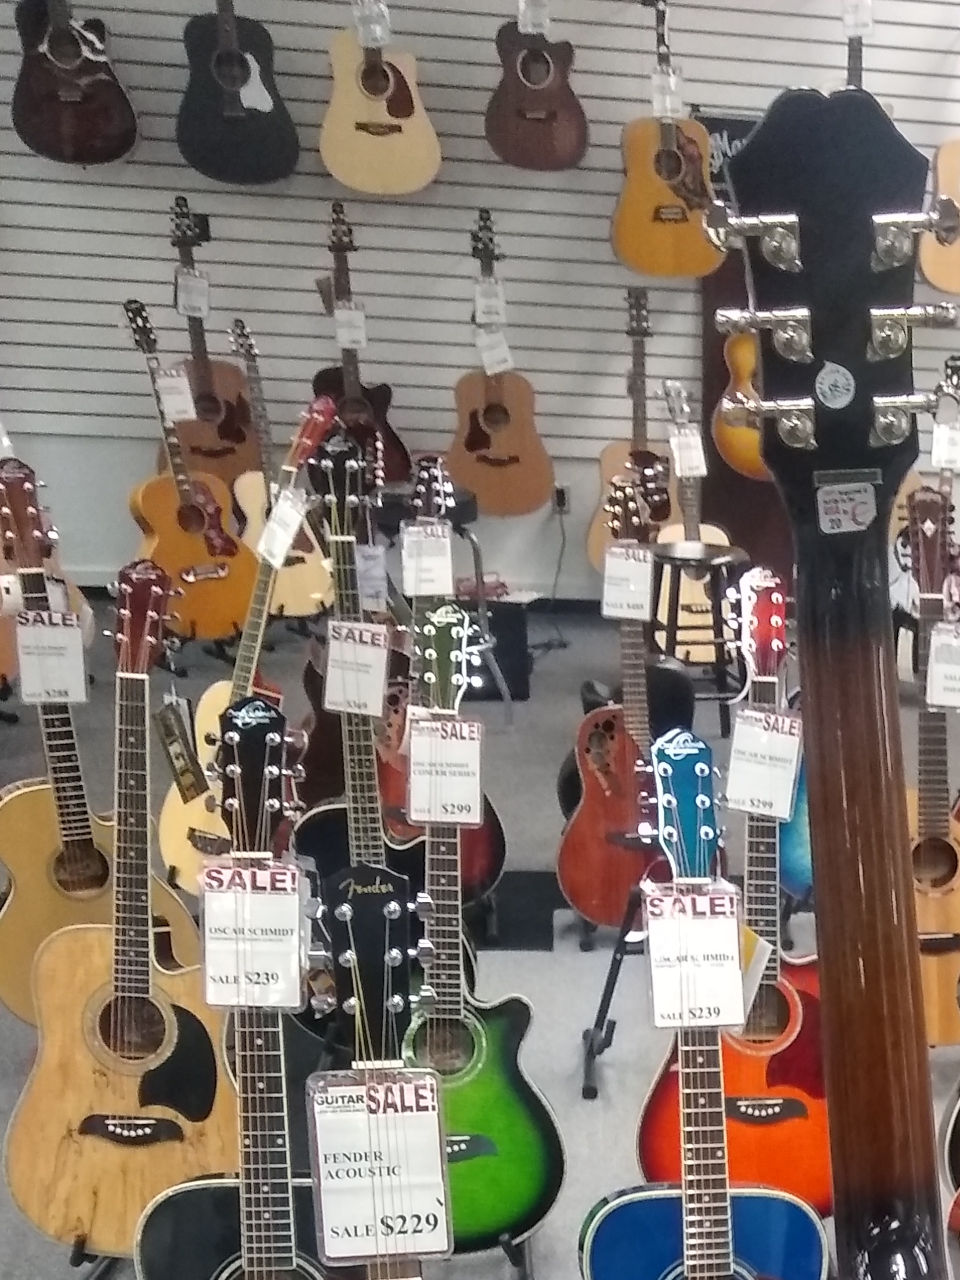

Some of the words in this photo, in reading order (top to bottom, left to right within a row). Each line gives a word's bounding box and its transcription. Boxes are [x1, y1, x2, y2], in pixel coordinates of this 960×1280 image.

[332, 625, 388, 647] SALE!
[441, 803, 472, 815] $299
[205, 868, 297, 892] SALE!
[338, 876, 394, 899] Fender
[648, 896, 736, 917] SALE!
[209, 926, 246, 936] OSCAR
[247, 927, 296, 937] SCHMIDT
[209, 975, 241, 985] SALE
[244, 971, 279, 985] $239
[688, 1006, 721, 1020] $239
[316, 1094, 365, 1106] GUITAR
[366, 1082, 437, 1115] SALE!
[323, 1150, 384, 1164] FENDER
[325, 1164, 402, 1181] ACOUSTIC
[330, 1224, 377, 1239] SALE
[380, 1212, 439, 1236] $229
